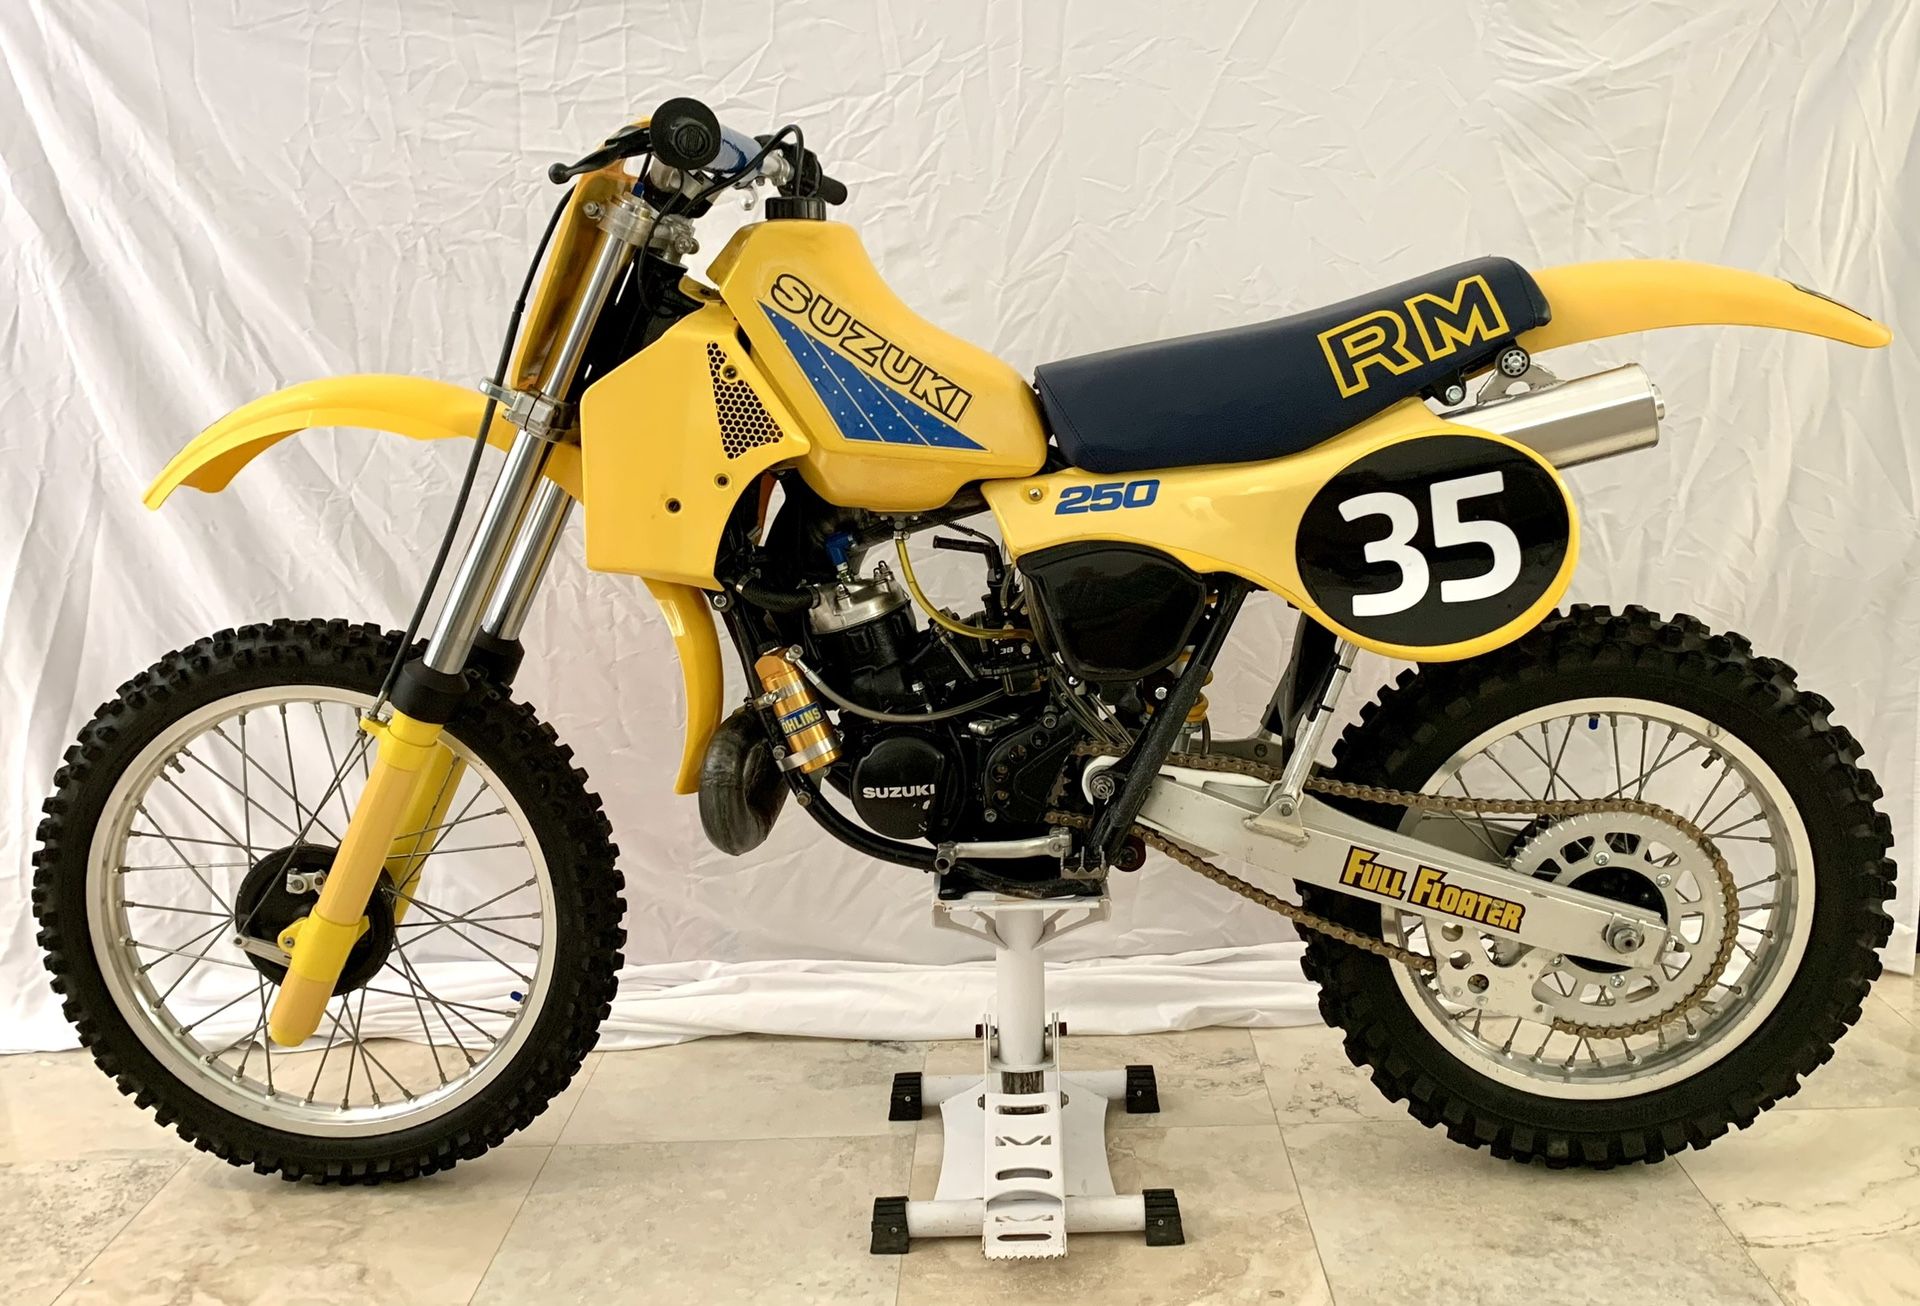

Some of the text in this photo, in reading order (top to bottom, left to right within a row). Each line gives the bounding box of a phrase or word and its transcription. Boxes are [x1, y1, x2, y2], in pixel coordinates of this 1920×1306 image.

[771, 273, 972, 422] SUZUKI
[1317, 274, 1510, 398] RM
[1055, 479, 1160, 515] 250
[1338, 470, 1521, 617] 35
[862, 783, 936, 799] SUZUKI
